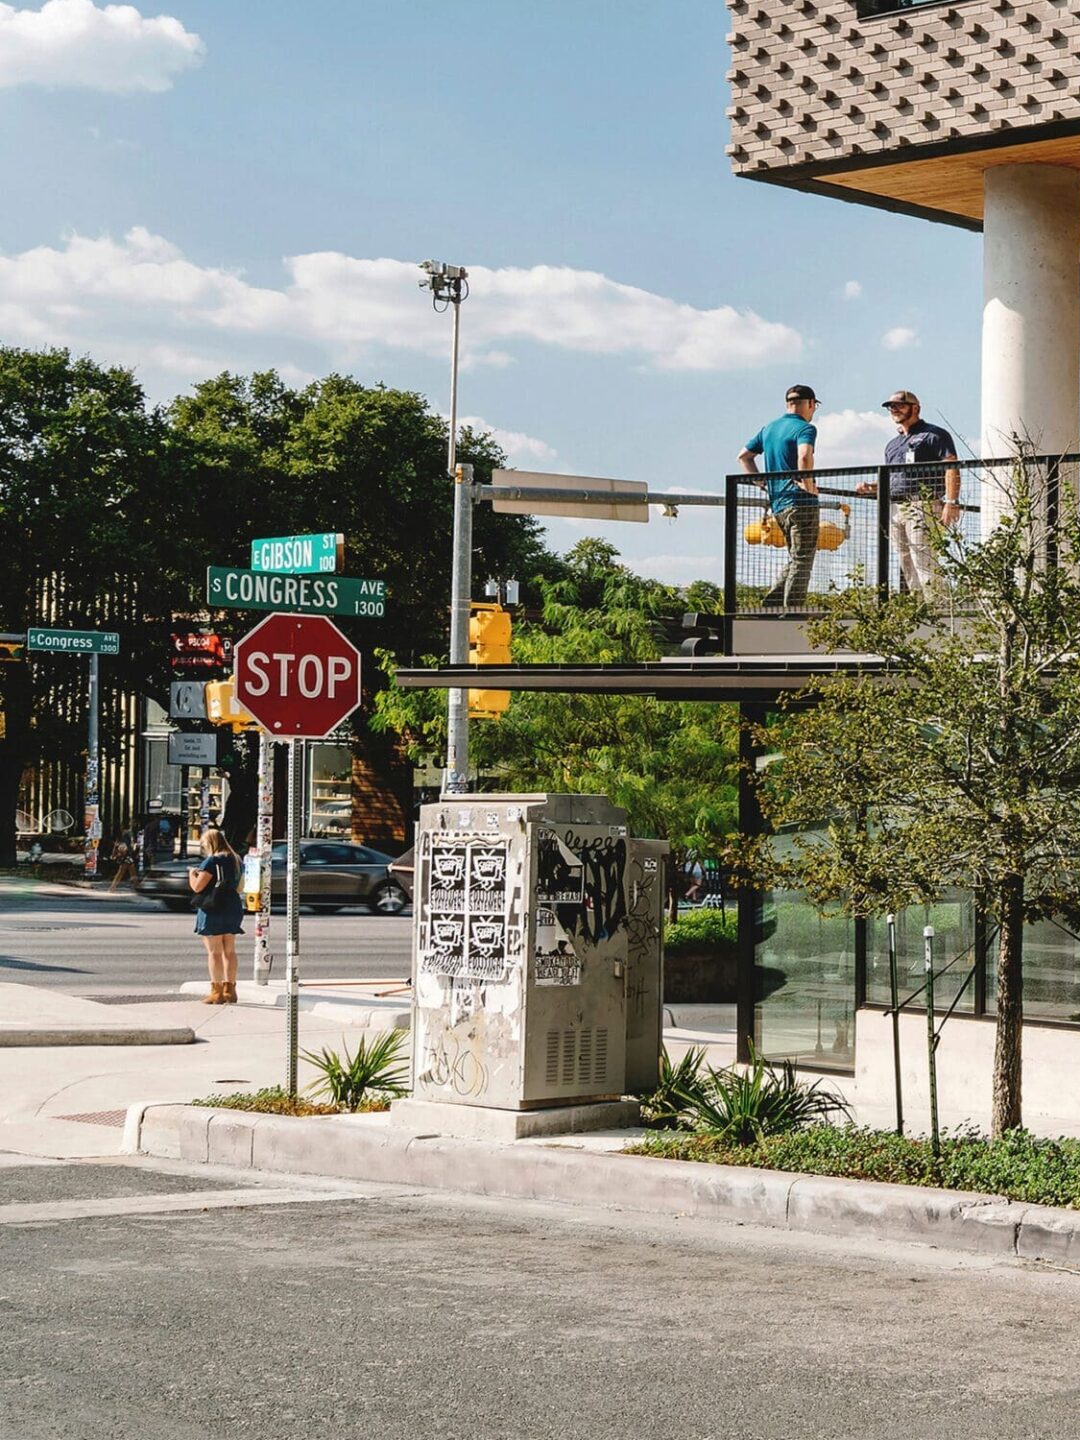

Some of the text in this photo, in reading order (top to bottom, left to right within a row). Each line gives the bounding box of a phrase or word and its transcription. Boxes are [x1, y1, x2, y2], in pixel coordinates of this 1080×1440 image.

[254, 534, 335, 570] E GIBSON ST
[319, 555, 336, 571] 100
[212, 572, 385, 608] S CONGRESS AVE
[354, 601, 385, 615] 1300
[30, 635, 36, 643] S
[37, 633, 93, 649] Congress
[100, 644, 117, 652] 1300
[244, 651, 352, 699] STOP
